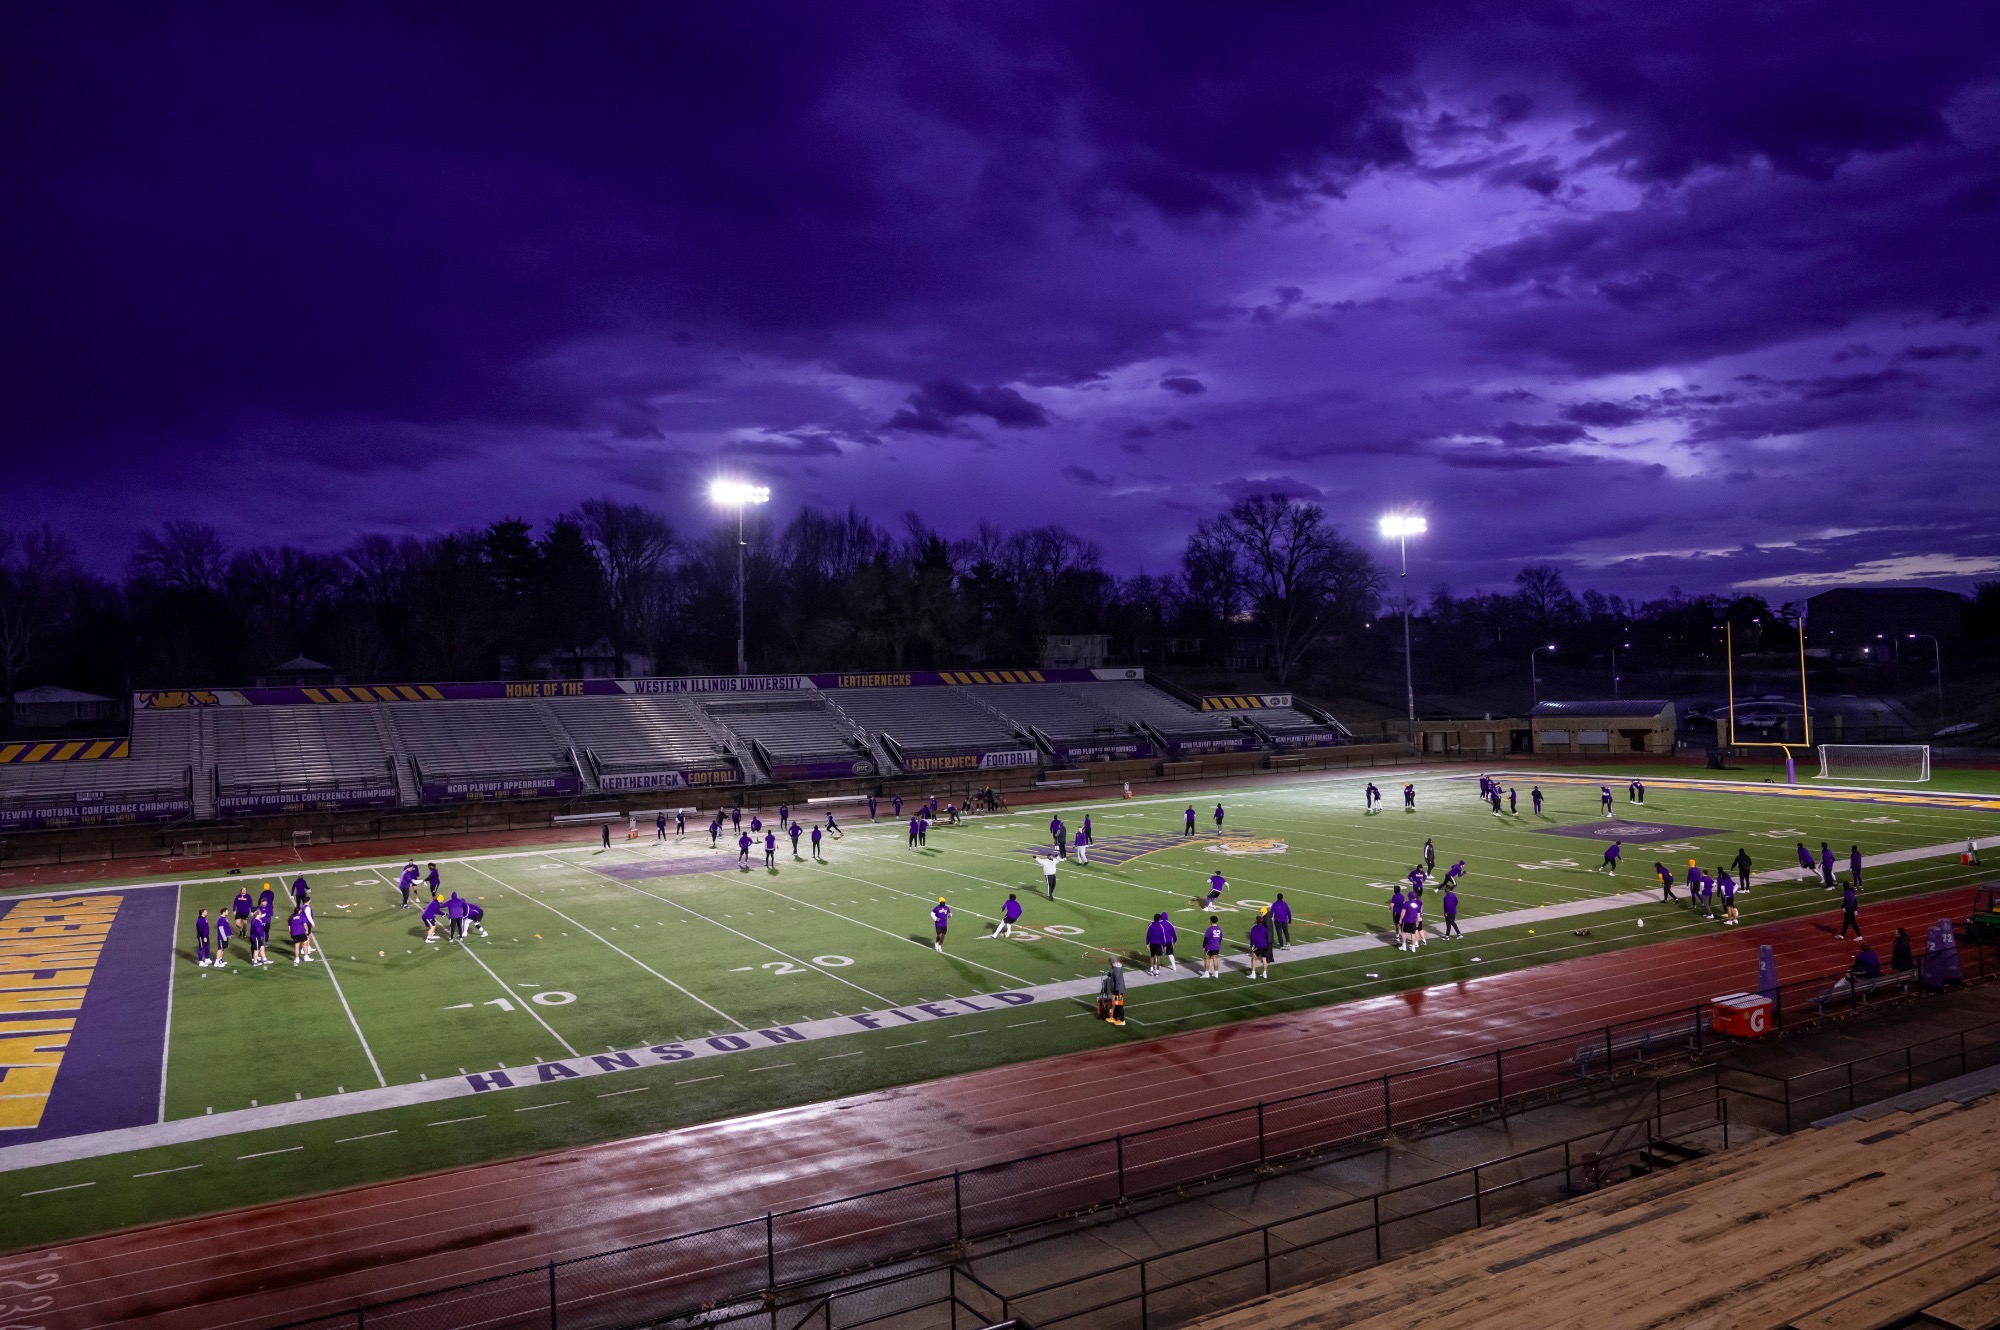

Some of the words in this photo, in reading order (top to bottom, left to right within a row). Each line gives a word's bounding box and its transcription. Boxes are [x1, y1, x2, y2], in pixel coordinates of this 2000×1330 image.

[634, 680, 688, 693] WESTERN
[691, 679, 737, 692] ILLINOIS
[740, 677, 802, 691] UNIVERSITY
[838, 674, 912, 688] LEATHERNECKS
[505, 683, 540, 698] HOME
[543, 683, 557, 696] OF
[562, 682, 584, 696] THE
[905, 756, 978, 772] LEATHERNECK
[986, 752, 1033, 767] FOOTBALL
[602, 774, 679, 790] LEATHERNECK
[688, 770, 737, 785] FOOTBALL
[447, 784, 468, 793] NCAA
[470, 782, 502, 792] PLAYOFF
[503, 780, 556, 790] APPEARANCES
[220, 797, 259, 807] GATEWAY
[261, 794, 301, 804] FOOTBALL
[302, 791, 351, 802] CONFERENCE
[352, 788, 396, 799] CHAMPIONS
[36, 806, 79, 818] FOOTBALL
[82, 803, 137, 815] CONFERENCE
[140, 801, 189, 812] CHAMPIONS
[761, 954, 855, 976] 20
[484, 991, 577, 1012] 10
[1750, 1008, 1765, 1033] G
[465, 1026, 807, 1092] HANSON
[848, 992, 1035, 1029] FIELD
